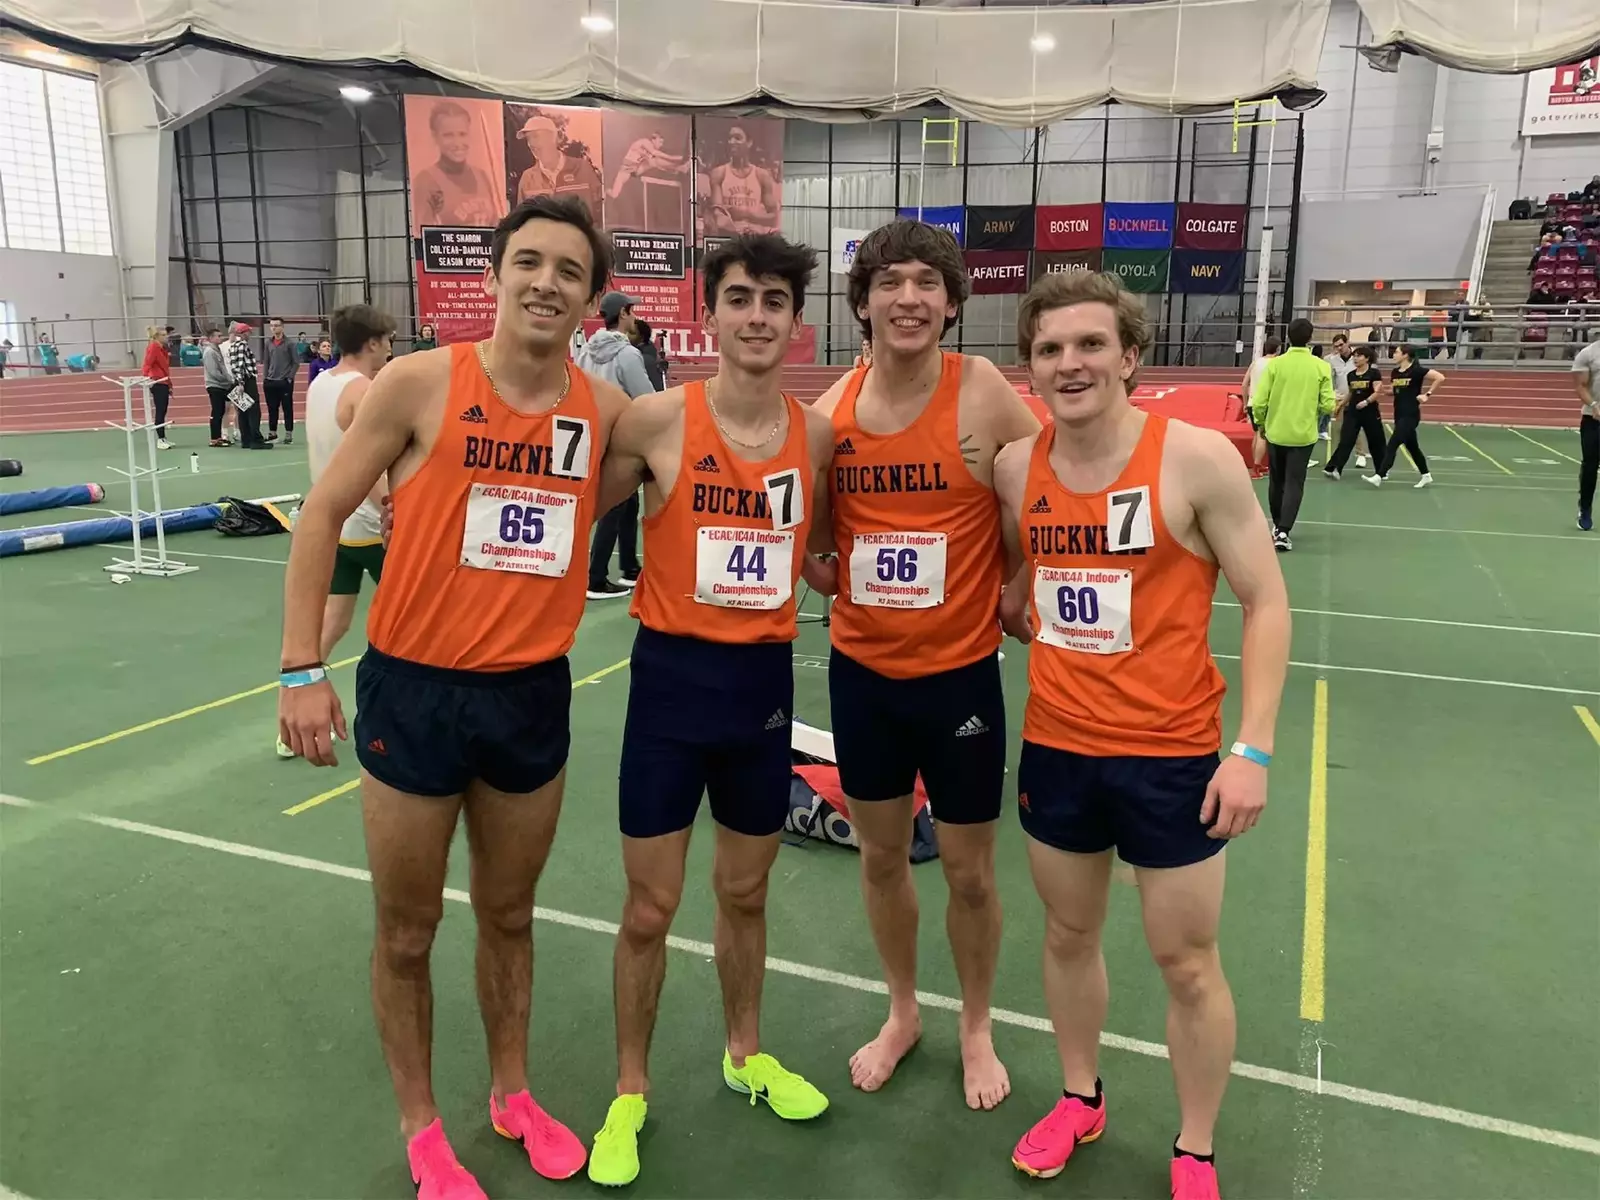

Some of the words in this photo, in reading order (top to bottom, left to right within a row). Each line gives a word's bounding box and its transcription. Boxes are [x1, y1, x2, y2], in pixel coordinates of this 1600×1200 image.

[983, 221, 1015, 233] ARMY
[1050, 219, 1089, 233] BOSTON
[1108, 218, 1169, 232] BUCKNELL
[1185, 219, 1238, 233] COLGATE
[441, 233, 455, 243] THE
[456, 233, 482, 243] SHARON
[615, 239, 630, 248] THE
[630, 239, 651, 249] DAVID
[438, 257, 464, 267] SEASON
[629, 251, 667, 261] VALENTINE
[625, 262, 673, 272] INVITATIONAL
[967, 265, 1025, 279] LAFAYETTE
[1047, 263, 1088, 275] LEHIGH
[1113, 263, 1157, 277] LOYOLA
[1190, 265, 1221, 278] NAVY
[460, 415, 488, 424] adidas
[557, 419, 583, 471] 7
[464, 436, 583, 481] BUCKNE
[693, 465, 720, 474] adidas
[836, 463, 948, 493] BUCKNELL
[482, 487, 535, 503] ECAC/IC4A
[535, 493, 567, 507] Indoor
[693, 483, 772, 519] BUCKN
[768, 473, 794, 525] 7
[499, 504, 545, 545] 65
[1112, 491, 1142, 546] 7
[708, 530, 755, 543] ECAC/IC4A
[756, 532, 786, 545] Indoor
[863, 534, 905, 545] ECAC/IC4A
[906, 535, 937, 546] Indoor
[1029, 525, 1146, 556] BUCKNE
[481, 542, 556, 562] Championships
[504, 561, 540, 571] ATHLETIC
[726, 545, 767, 581] 44
[876, 548, 918, 582] 56
[1042, 569, 1083, 583] ECAC/IC4A
[1086, 571, 1120, 584] Indoor
[713, 583, 778, 597] Championships
[865, 581, 930, 596] Championships
[736, 599, 766, 608] ATHLETIC
[886, 598, 914, 607] ATHLETIC
[1057, 585, 1100, 625] 60
[1051, 622, 1115, 640] Championships
[1072, 640, 1100, 651] ATHLETIC
[765, 718, 789, 730] adidas
[955, 726, 990, 737] adidas
